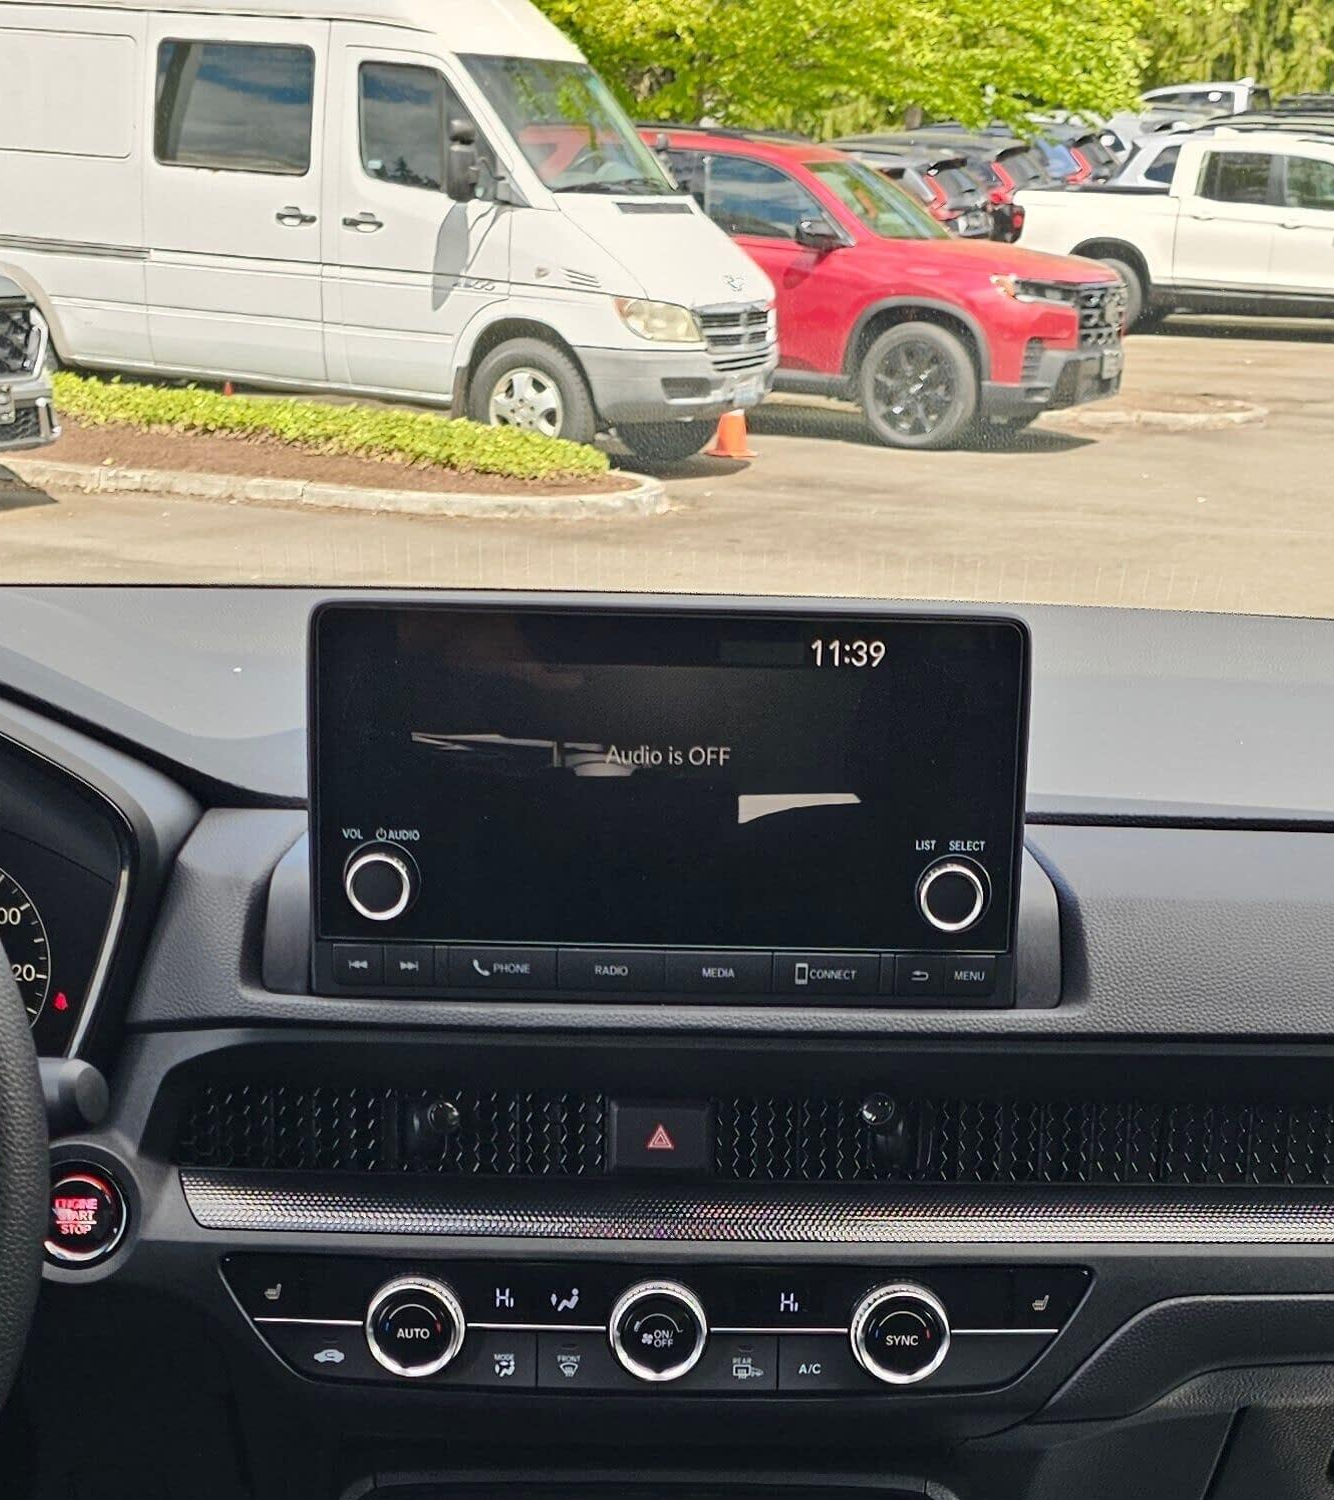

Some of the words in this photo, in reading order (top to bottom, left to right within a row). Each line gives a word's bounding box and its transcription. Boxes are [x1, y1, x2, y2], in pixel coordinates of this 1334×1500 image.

[809, 639, 886, 668] 11:39
[606, 745, 663, 765] Audio
[668, 745, 683, 765] is
[688, 746, 731, 766] OFF
[342, 828, 364, 840] VOL
[388, 829, 421, 841] AUDIO
[915, 839, 937, 851] LIST
[948, 840, 986, 851] SELECT
[10, 964, 36, 982] 20
[493, 963, 531, 974] PHONE
[594, 965, 629, 976] RADIO
[702, 967, 735, 979] MEDIA
[809, 969, 857, 981] CONNECT
[954, 971, 985, 982] MENU
[61, 1224, 92, 1235] STOP
[397, 1328, 430, 1339] AUTO
[653, 1329, 674, 1339] ON/
[653, 1338, 674, 1348] OFF
[885, 1334, 919, 1347] SYNC
[494, 1354, 515, 1362] MODE
[557, 1354, 581, 1364] FRONT
[798, 1362, 822, 1375] A/C
